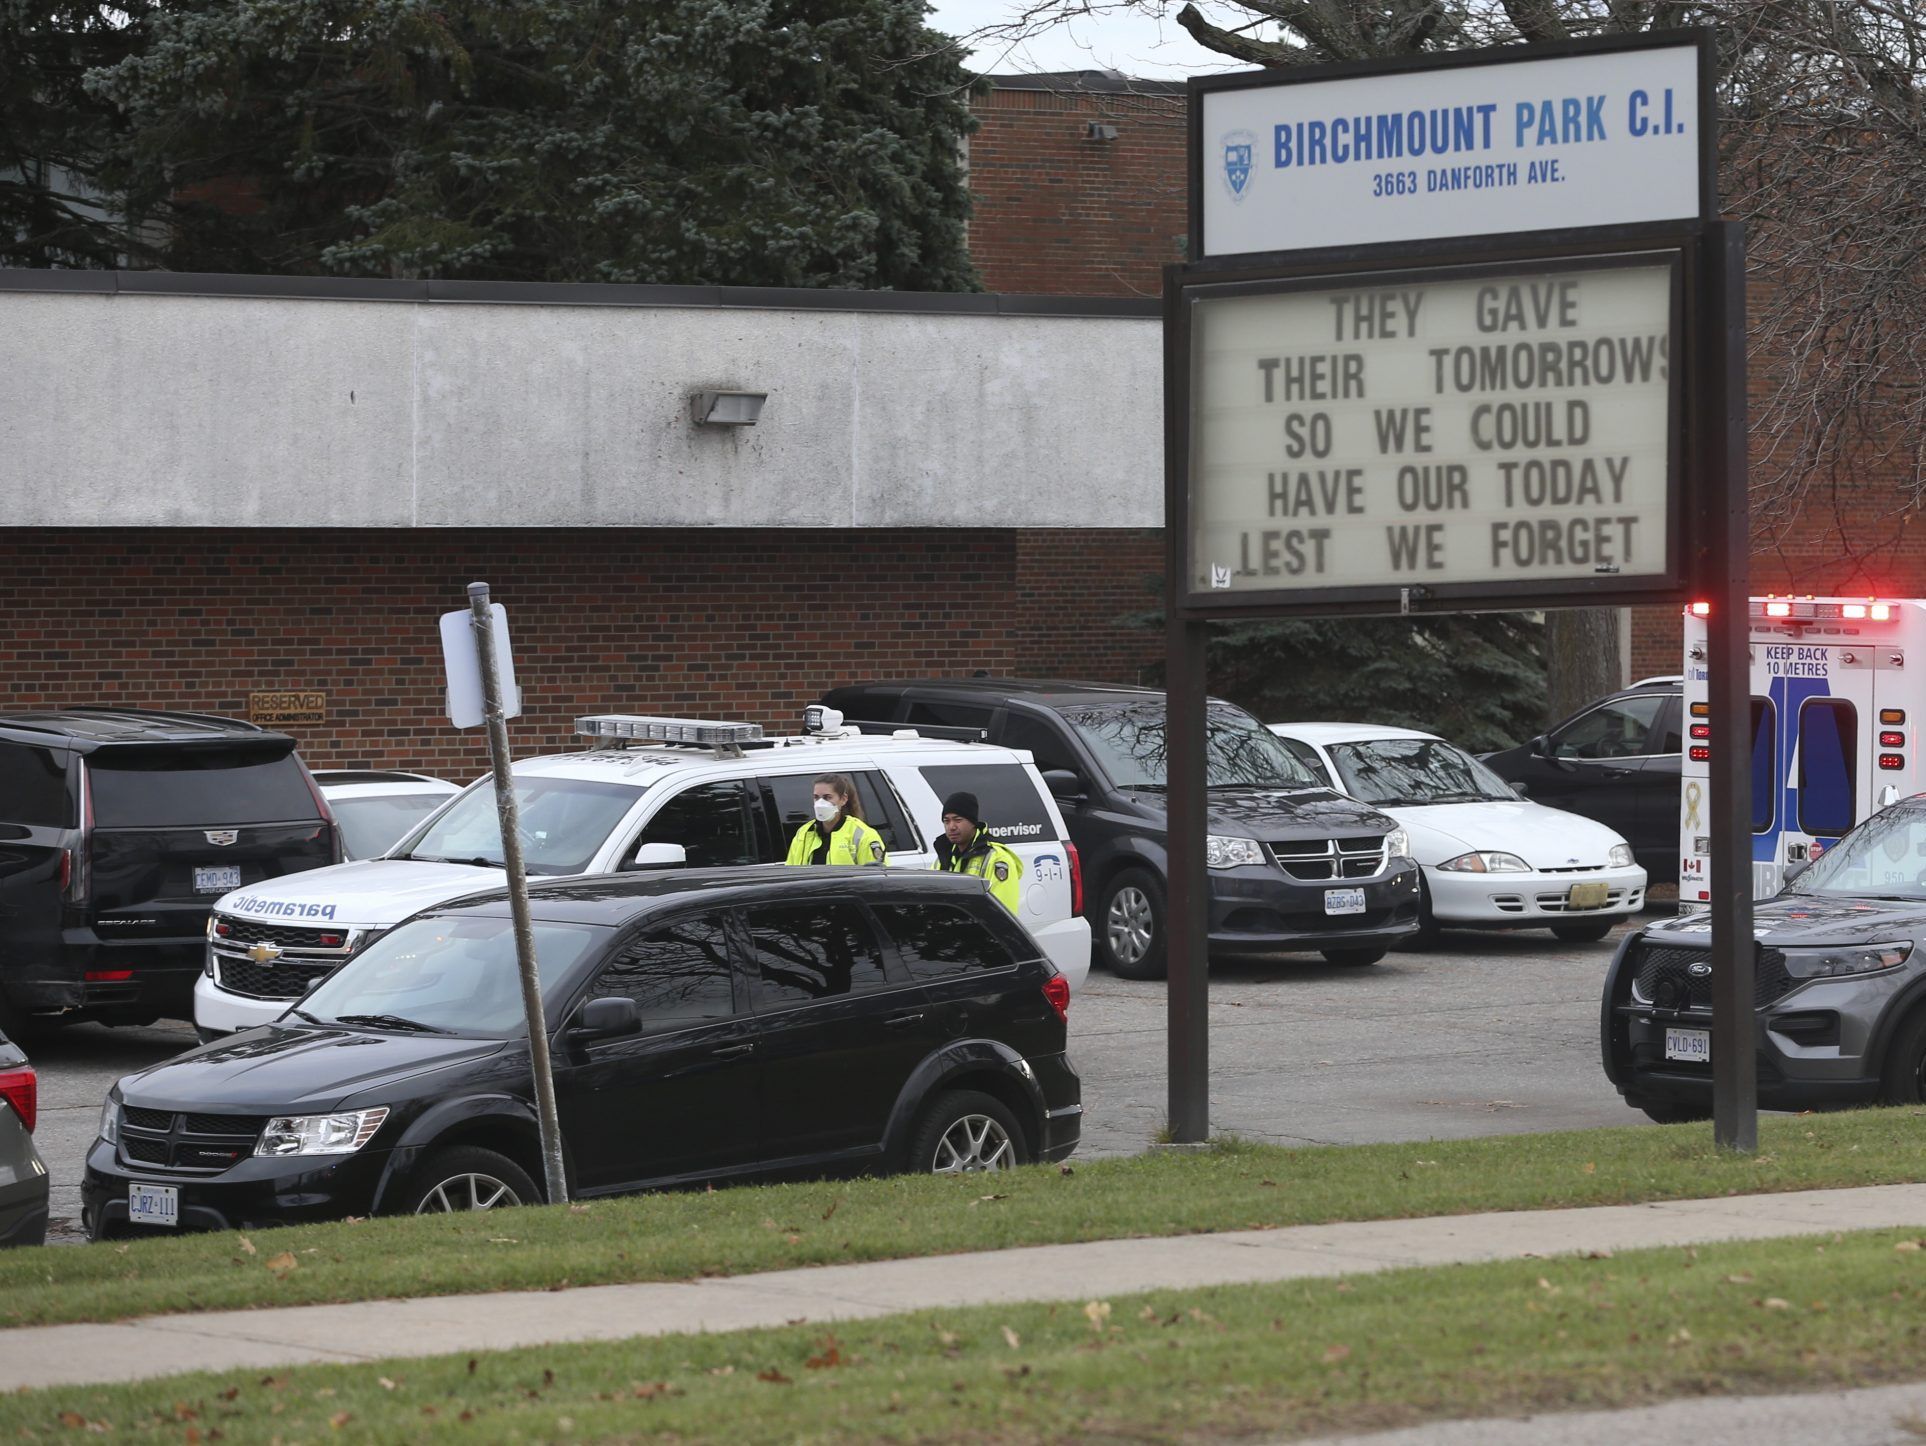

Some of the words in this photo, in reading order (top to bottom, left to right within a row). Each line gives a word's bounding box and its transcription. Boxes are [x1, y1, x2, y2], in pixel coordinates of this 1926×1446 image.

[1274, 104, 1497, 169] BIRCHMOUNT
[1516, 95, 1607, 148] PARK
[1629, 88, 1685, 138] C.I.
[1373, 172, 1418, 198] 3663
[1427, 163, 1518, 193] DANFORTH
[1527, 159, 1566, 185] AVE.
[1330, 290, 1424, 342] THEY
[1476, 280, 1579, 334] GAVE
[1257, 353, 1366, 404] THEIR
[1284, 412, 1333, 459] SO
[1374, 407, 1433, 454] WE
[1470, 400, 1591, 451] COULD
[1267, 468, 1365, 518] HAVE
[1397, 464, 1470, 513] OUR
[1497, 456, 1630, 508] TODAY
[1240, 528, 1331, 576] LEST
[1386, 523, 1445, 571] WE
[1491, 516, 1640, 568] FORGET
[1766, 646, 1794, 660] KEEP
[1797, 647, 1828, 661] BACK
[1766, 662, 1780, 675] 10
[1783, 662, 1828, 676] METRES
[252, 693, 325, 711] RESERVED
[1885, 871, 1905, 884] 950
